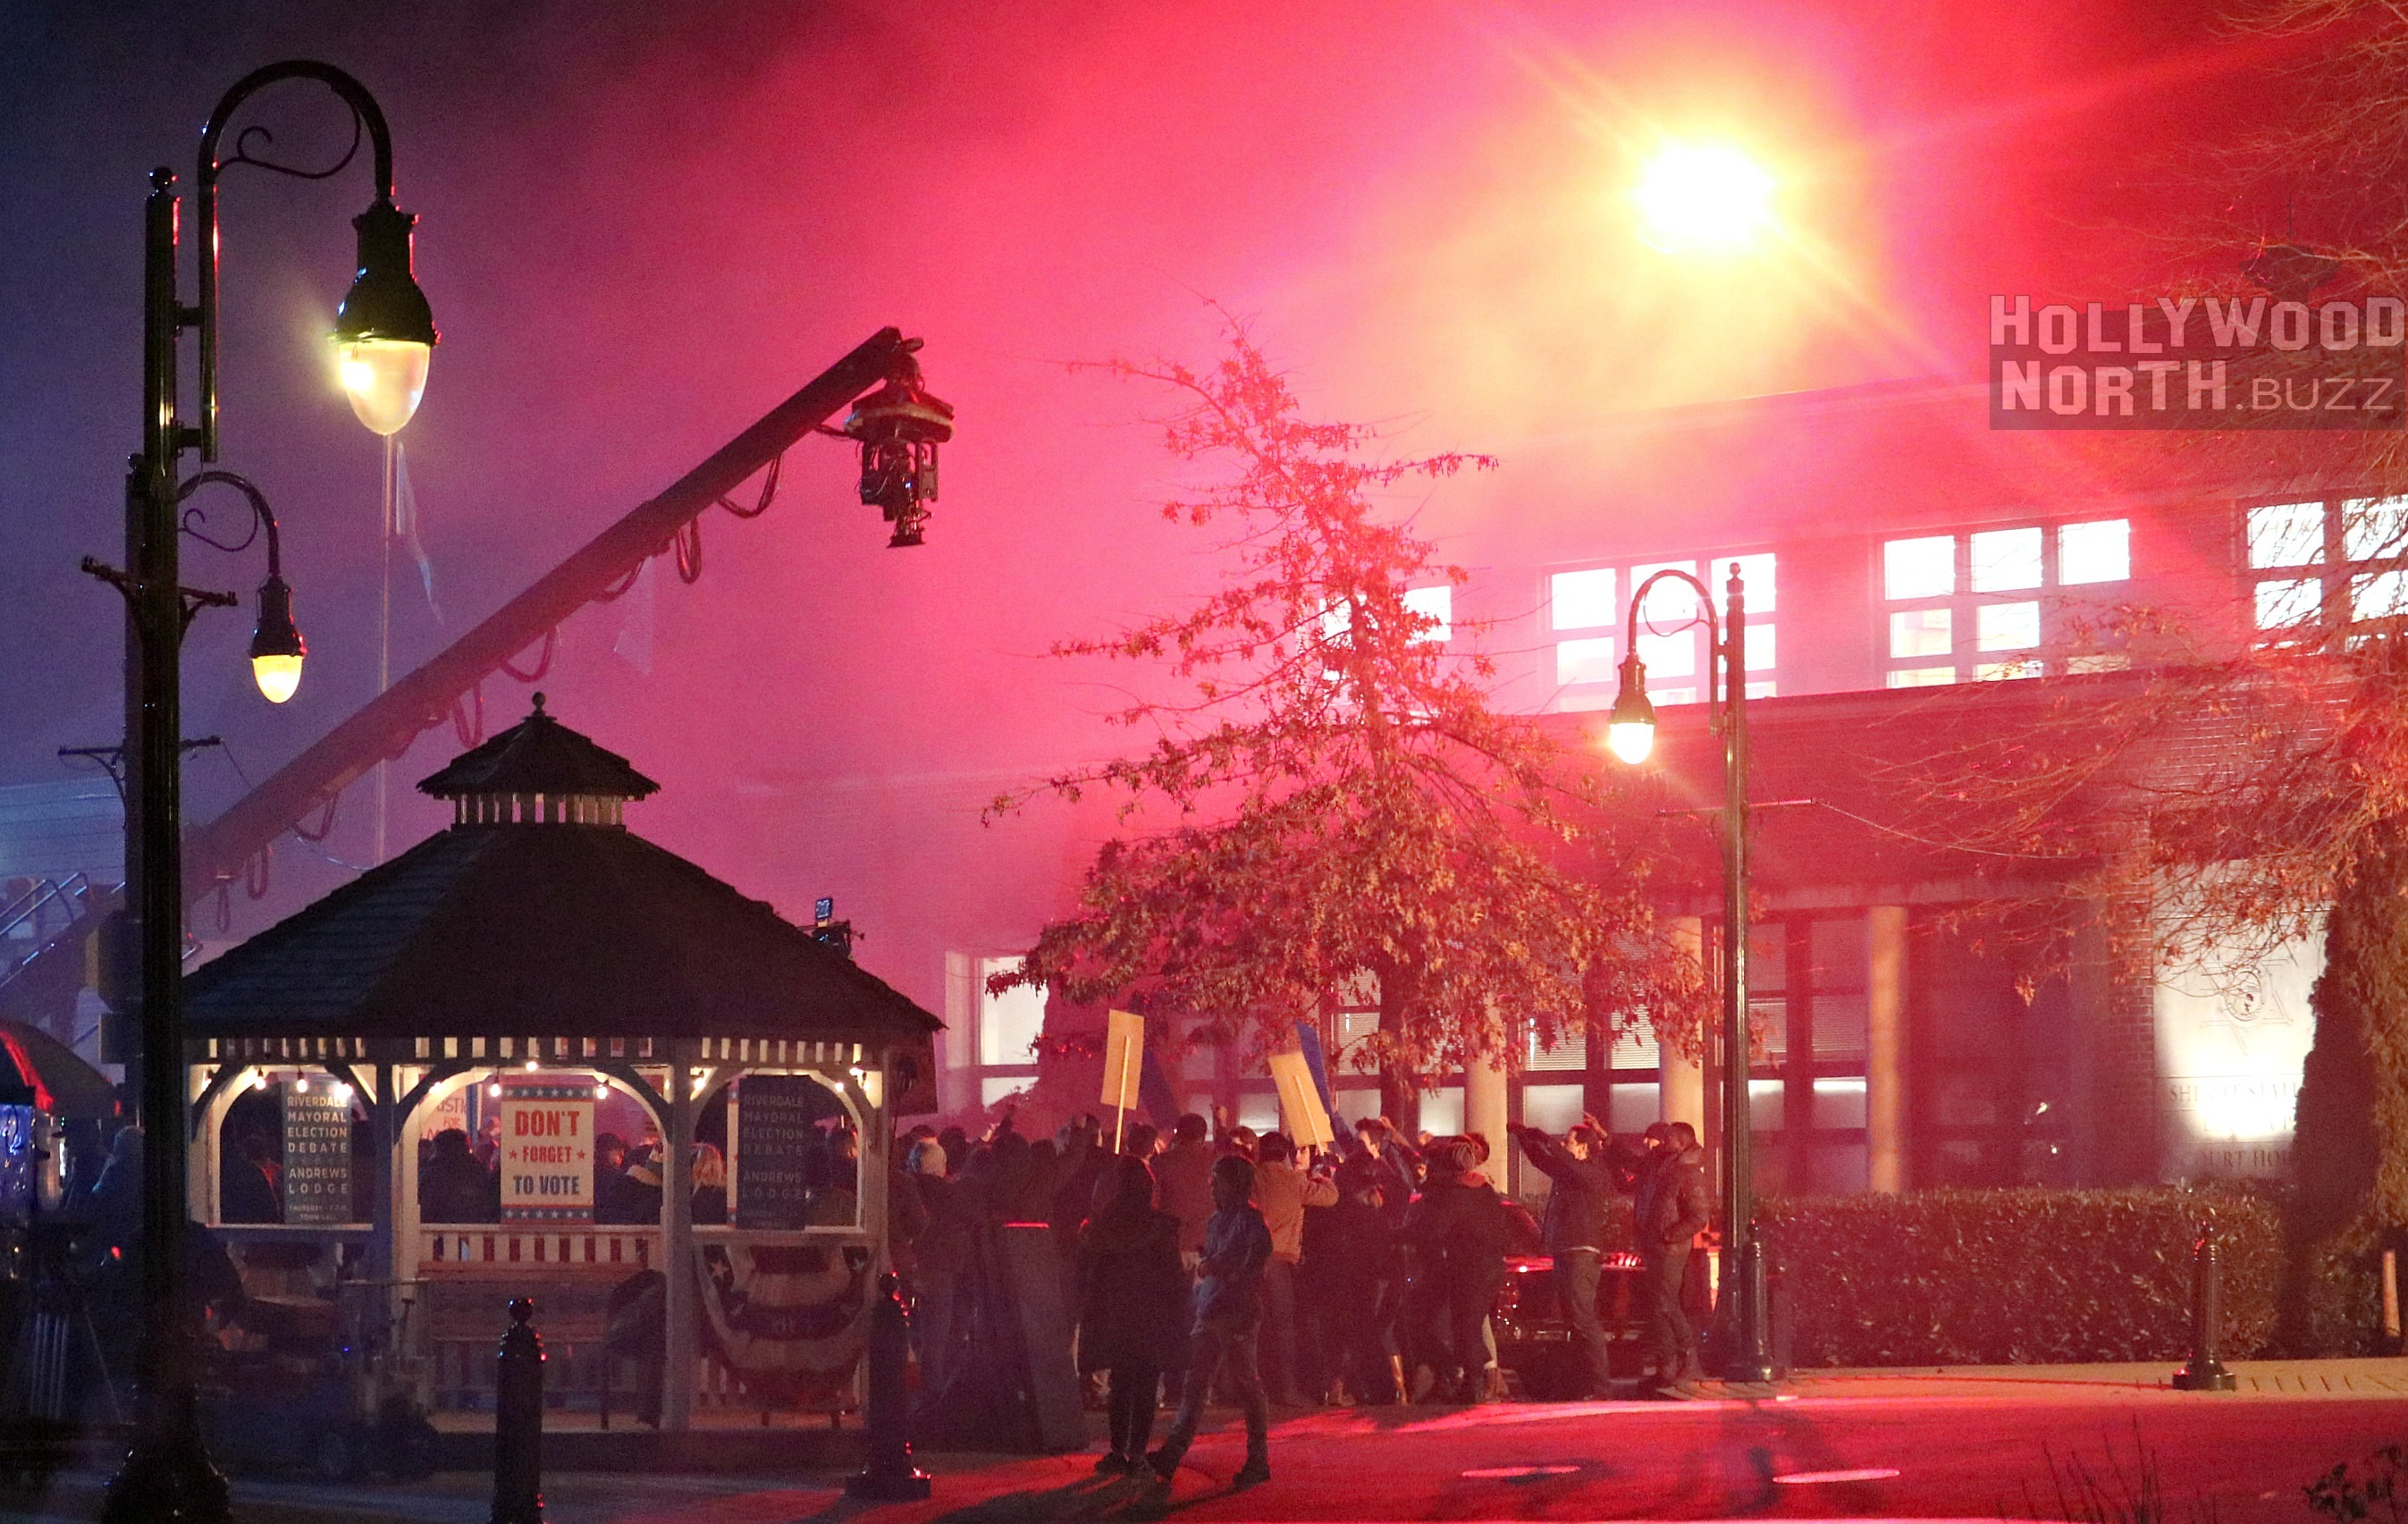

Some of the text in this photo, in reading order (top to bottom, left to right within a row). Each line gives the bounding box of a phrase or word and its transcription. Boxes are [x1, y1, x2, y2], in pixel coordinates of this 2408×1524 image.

[287, 1096, 348, 1107] RIVERDALE
[287, 1111, 347, 1123] MAYORAL
[514, 1109, 580, 1137] DON'T
[287, 1126, 348, 1138] ELECTION
[288, 1141, 348, 1154] DEBATE
[522, 1145, 572, 1164] FORGET
[289, 1167, 348, 1179] ANDREWS
[288, 1183, 348, 1194] LODGE
[512, 1175, 580, 1195] TO VOTE
